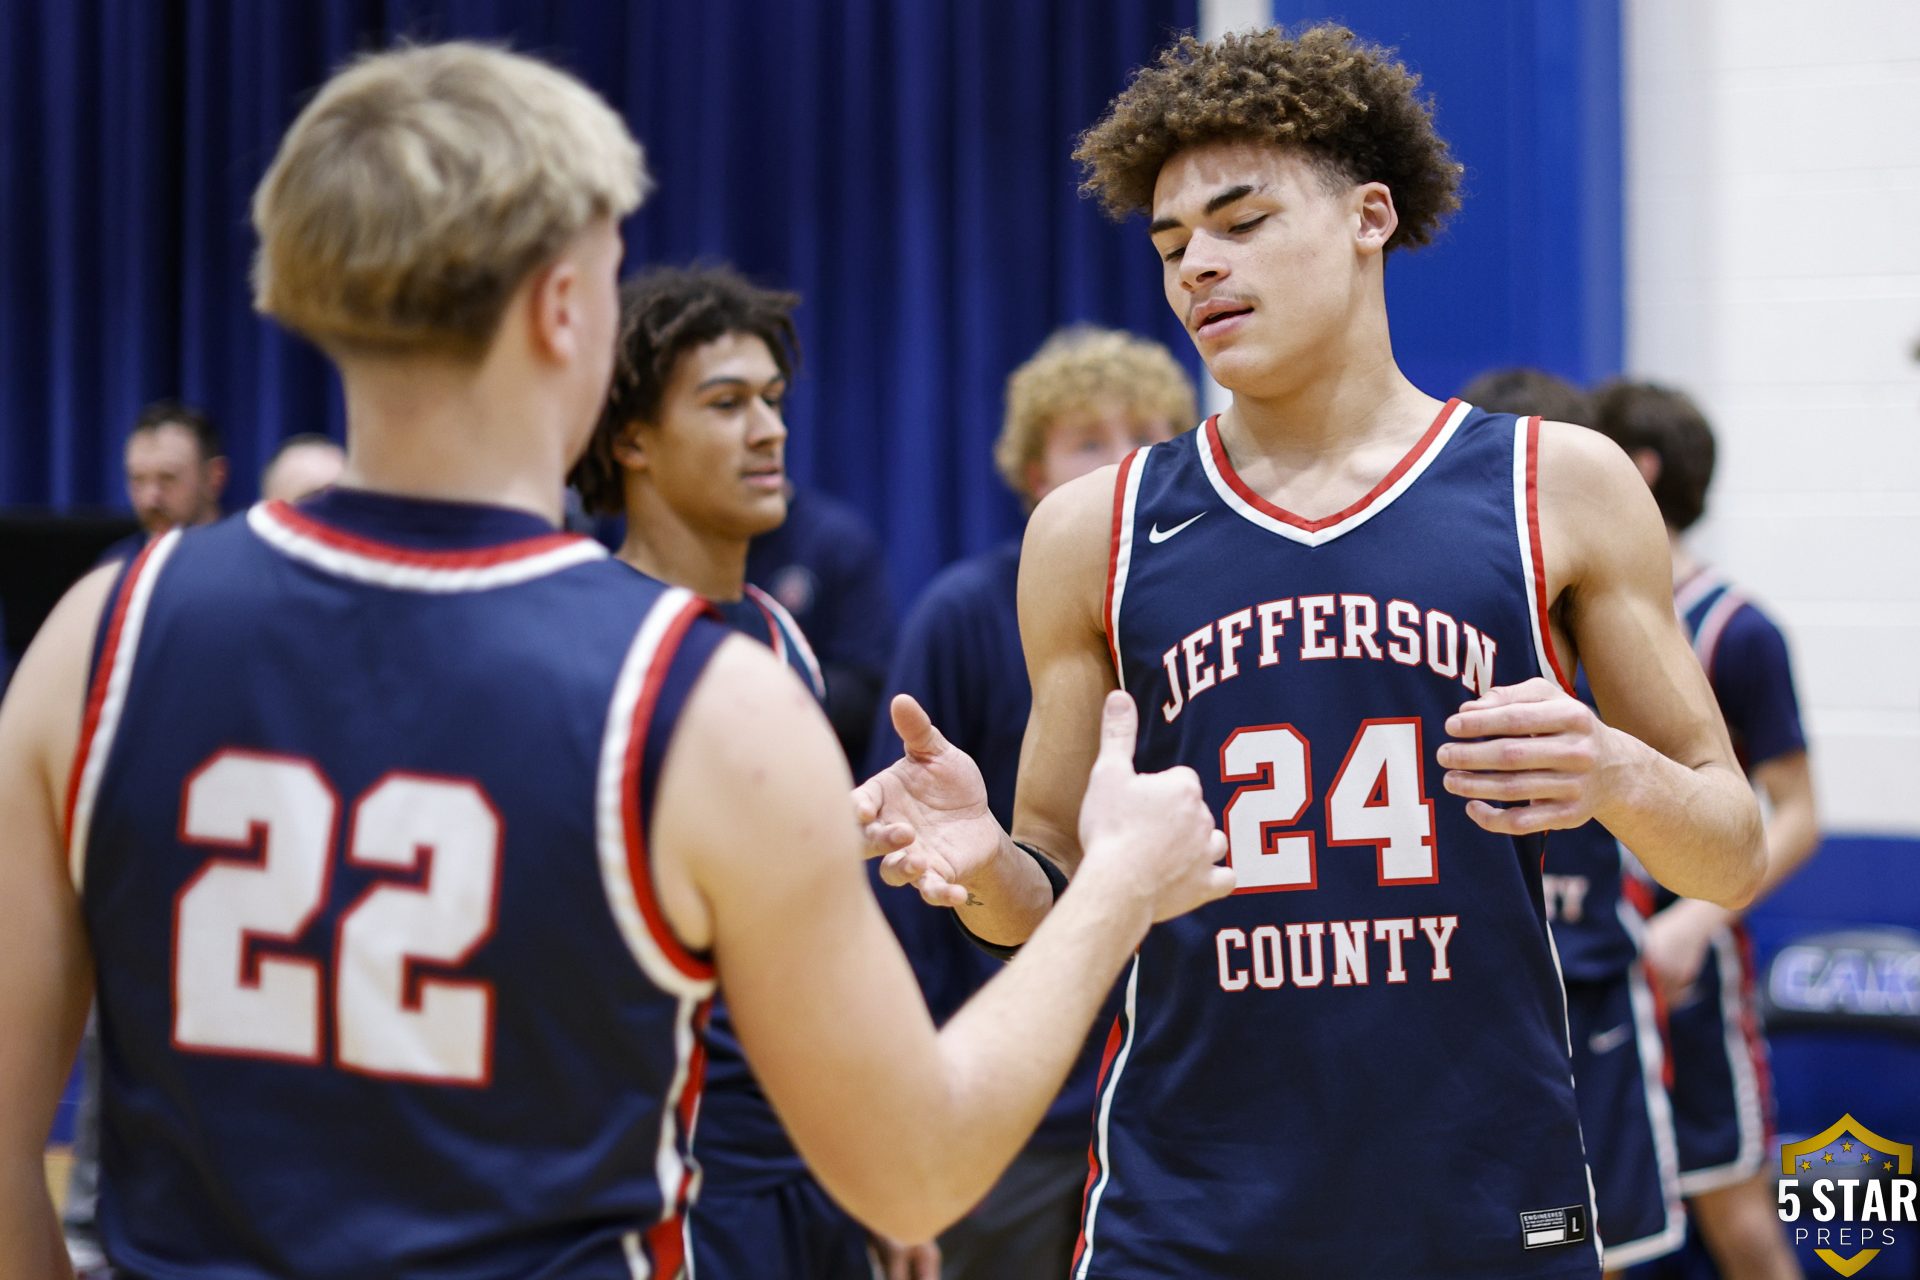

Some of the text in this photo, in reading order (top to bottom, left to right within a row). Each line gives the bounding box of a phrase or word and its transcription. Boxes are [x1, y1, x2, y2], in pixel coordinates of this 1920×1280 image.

[1162, 593, 1497, 723] JEFFERSON
[1219, 716, 1440, 895] 24
[171, 746, 506, 1089] 22
[1215, 916, 1459, 992] COUNTY
[1572, 1216, 1580, 1233] L
